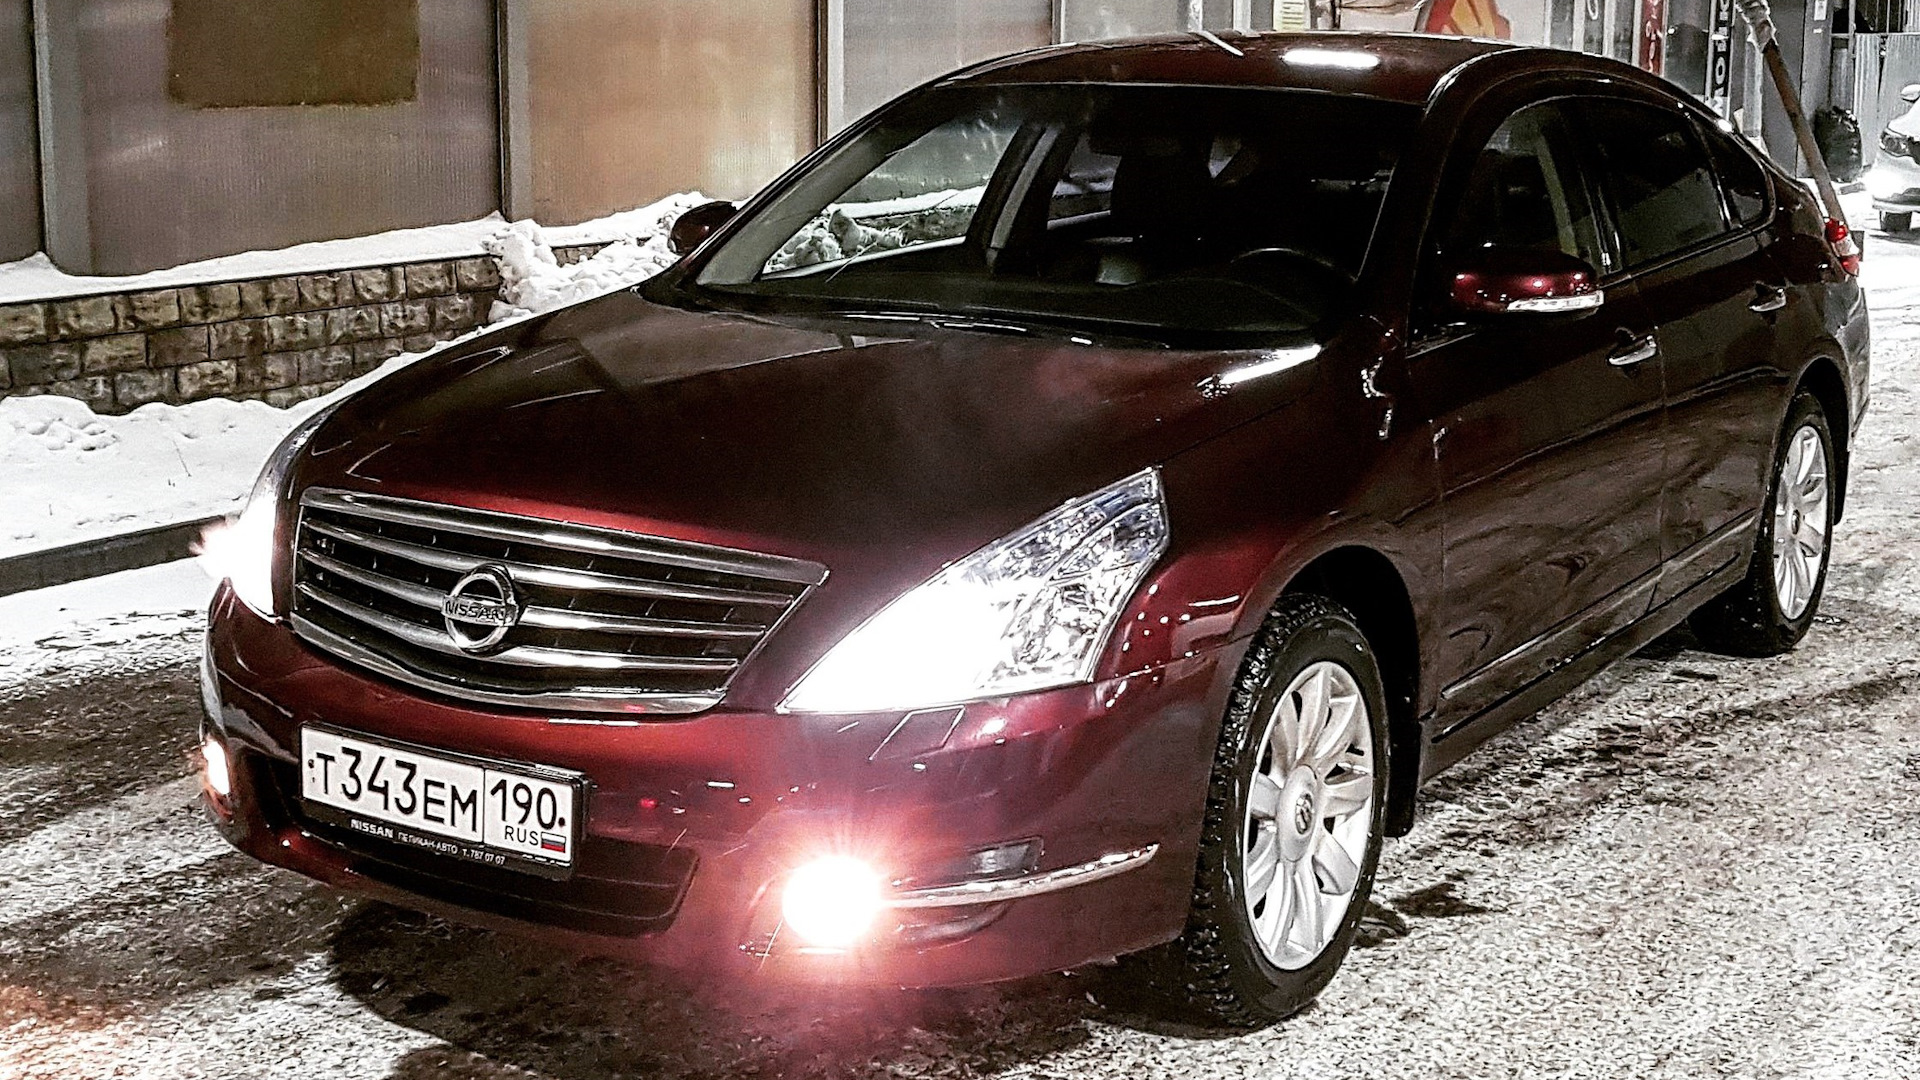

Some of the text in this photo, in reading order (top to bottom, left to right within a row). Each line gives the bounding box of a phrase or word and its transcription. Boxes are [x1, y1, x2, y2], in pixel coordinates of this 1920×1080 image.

[445, 600, 506, 623] NISSAN
[316, 747, 558, 832] Т343ЕМ 190
[351, 819, 393, 838] NISSAN
[505, 825, 539, 847] RUS
